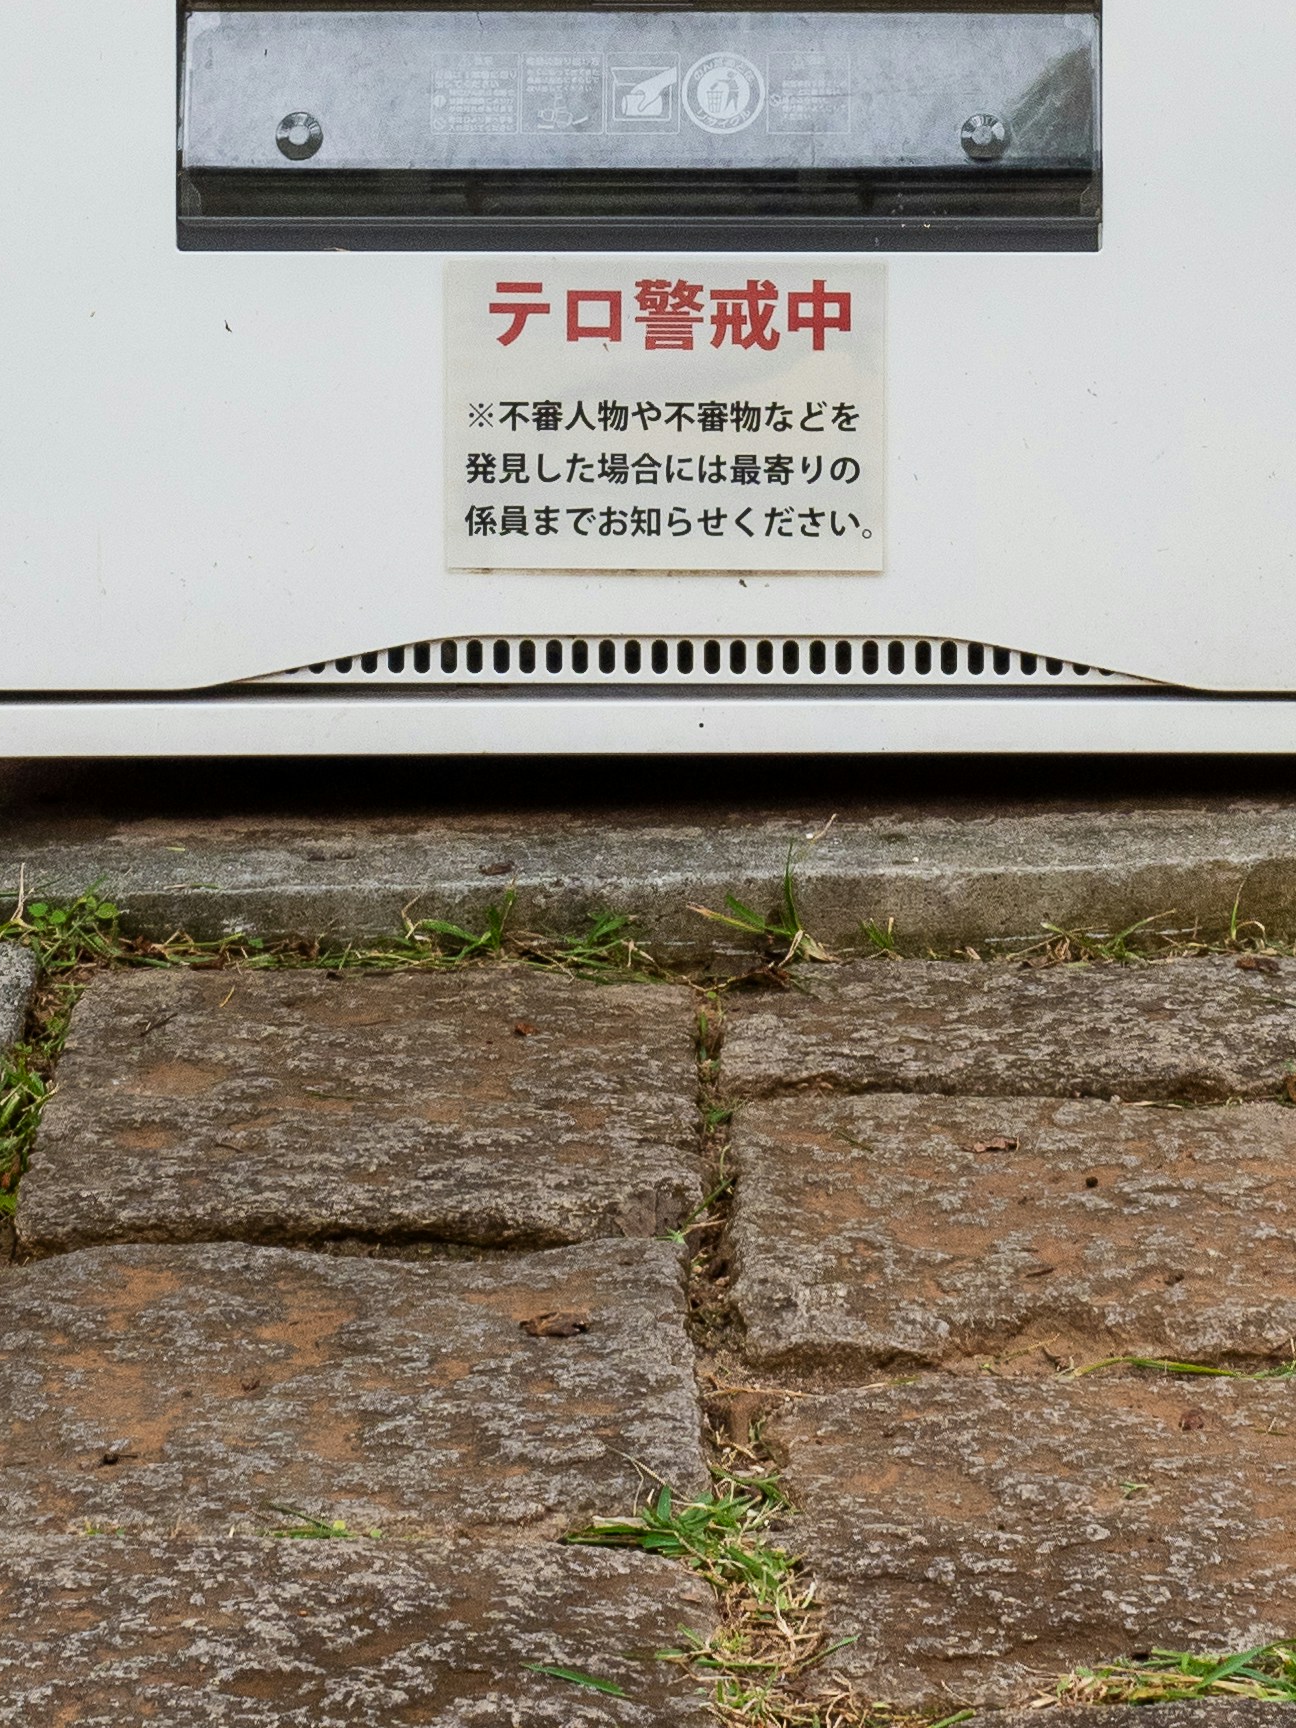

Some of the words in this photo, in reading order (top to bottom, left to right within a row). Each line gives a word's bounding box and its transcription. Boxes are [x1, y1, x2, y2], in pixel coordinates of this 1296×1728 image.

[488, 278, 852, 352] テロ警戒中
[468, 400, 860, 433] ※不審人物や不審物などを
[466, 452, 861, 485] 発見した場合には最寄りの
[464, 505, 873, 539] 係員までお知らせください。
